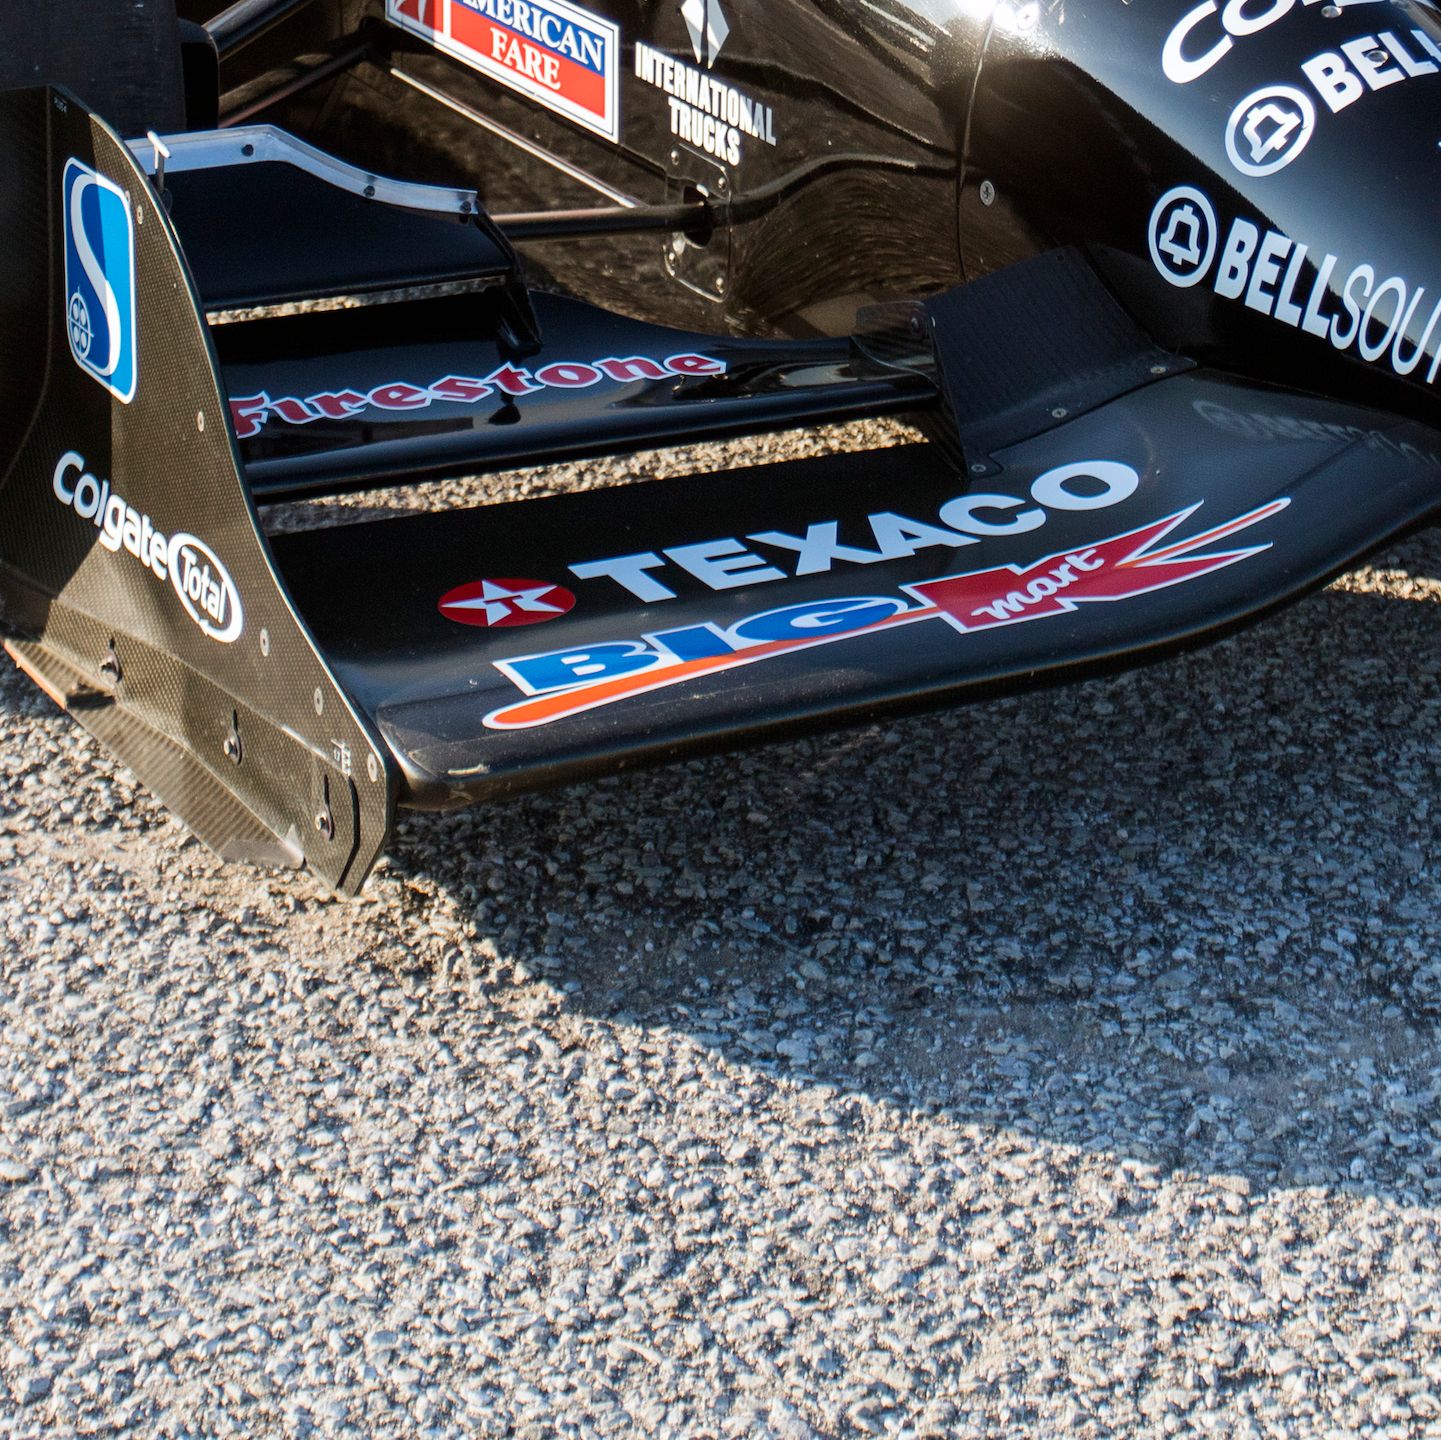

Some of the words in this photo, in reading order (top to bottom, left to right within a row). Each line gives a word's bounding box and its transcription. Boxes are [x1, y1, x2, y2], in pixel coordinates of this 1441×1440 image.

[490, 27, 561, 90] FARE
[635, 41, 777, 147] INTERNATIONAL
[668, 96, 741, 167] TRUCKS
[231, 346, 729, 441] Firestone
[52, 450, 169, 581] Colgate
[567, 459, 1142, 605] TEXACO
[178, 544, 228, 625] Total
[970, 543, 1107, 626] mart
[492, 595, 910, 697] BIG
